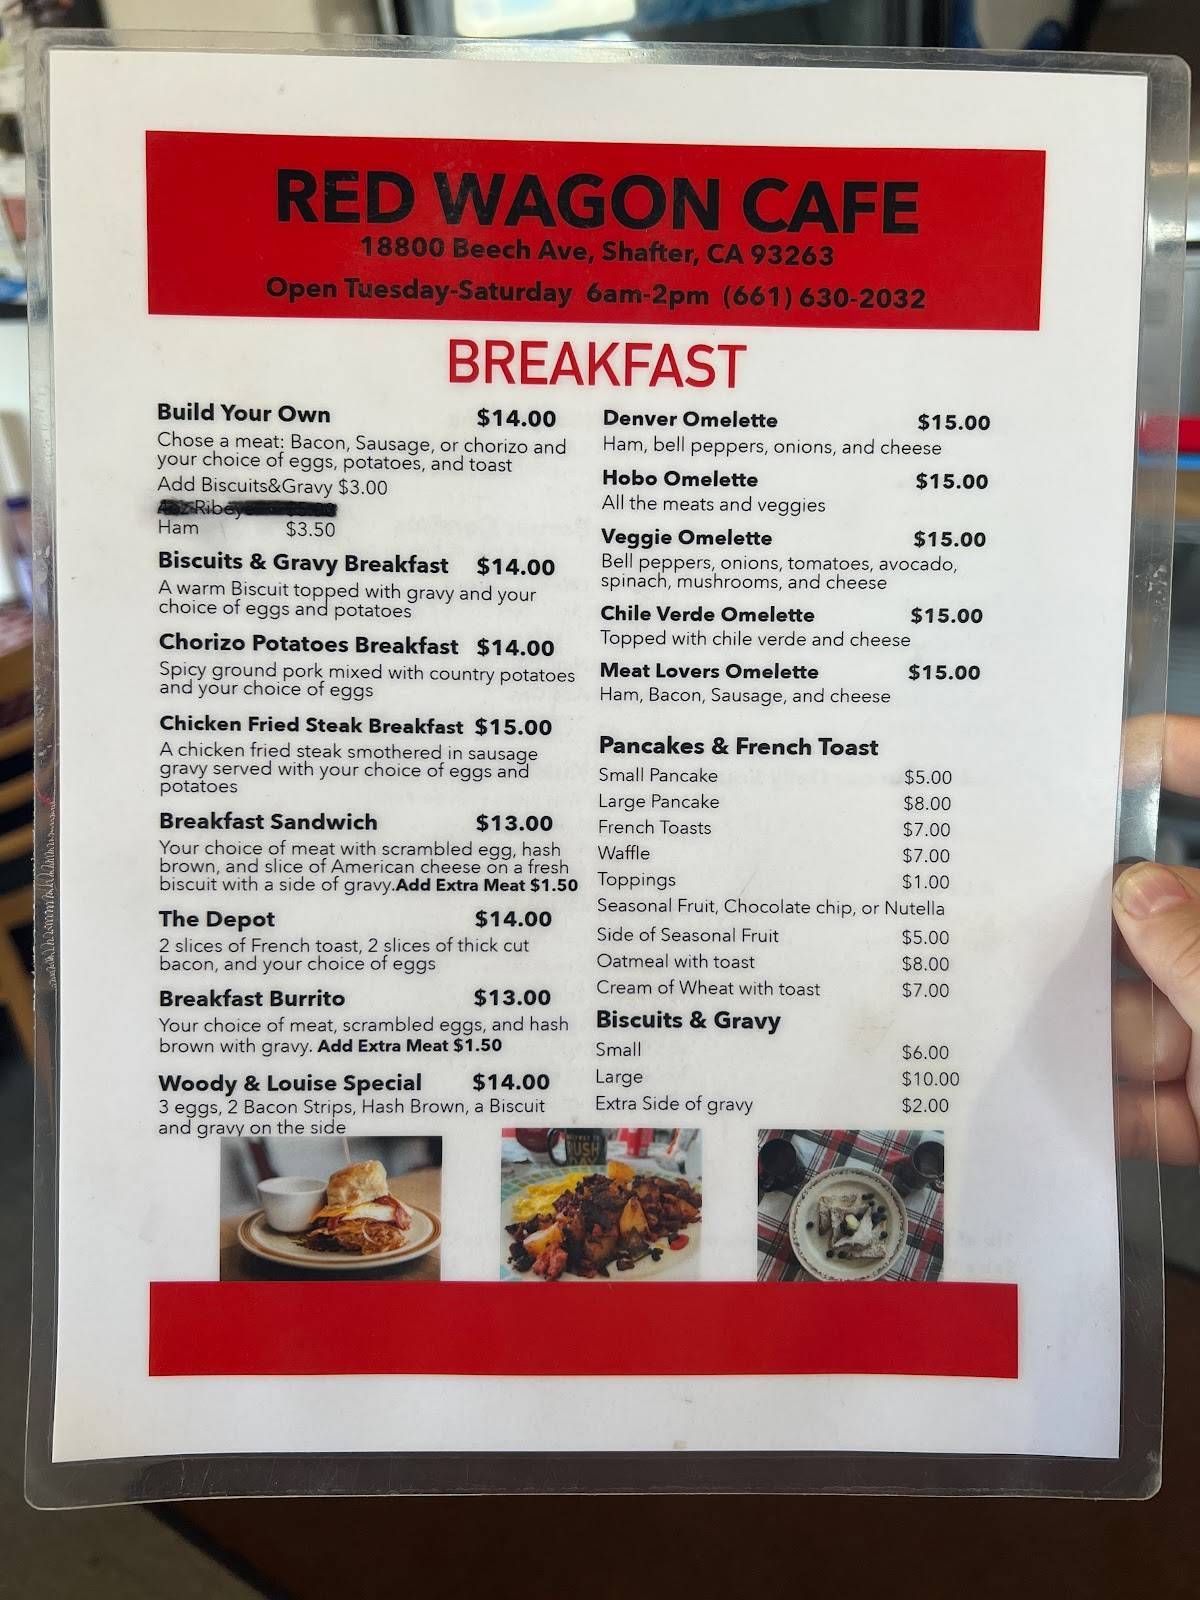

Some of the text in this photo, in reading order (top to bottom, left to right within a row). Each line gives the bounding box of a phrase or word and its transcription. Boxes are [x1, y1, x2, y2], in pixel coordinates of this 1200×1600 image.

[277, 168, 919, 234] RED WAGON CAFE
[361, 236, 833, 266] 18800 Beech Ave, Shafter, CA 93263
[266, 276, 925, 310] Open Tuesday-Saturday 6am-2pm (661) 630-2032
[449, 338, 747, 389] BREAKFAST
[157, 402, 556, 428] Build Your Own $14.00
[603, 409, 991, 432] Denver Omelette $15.00
[603, 435, 942, 458] Ham, bell peppers, onions, and cheese
[157, 475, 388, 499] Add Biscuits&Gravy $3.00
[603, 469, 989, 491] Hobo Omelette $15.00
[158, 519, 335, 538] Ham $3.50
[601, 528, 986, 550] Veggie Omelette $15.00
[159, 550, 555, 577] Biscuits & Gravy Breakfast $14.00
[602, 552, 957, 574] Bell peppers, onions, tomatoes, avocado,
[601, 572, 887, 592] spinach, mushrooms, and cheese
[600, 604, 983, 625] Chile Verde Omelette $15.00
[159, 632, 555, 657] Chorizo Potatoes Breakfast $14.00
[600, 662, 981, 681] Meat Lovers Omelette $15.00
[600, 686, 891, 707] Ham, Bacon, Sausage, and cheese
[159, 714, 552, 737] Chicken Fried Steak Breakfast $15.00
[600, 735, 879, 756] Pancakes & French Toast
[599, 767, 952, 786] Small Pancake $5.00
[599, 793, 951, 812] Large Pancake $8.00
[160, 811, 553, 833] Breakfast Sandwich $13.00
[599, 818, 951, 838] French Toasts $7.00
[597, 844, 950, 864] Waffle $7.00
[597, 871, 950, 891] Toppings $1.00
[597, 897, 945, 919] Seasonal Fruit, Chocolate chip, or Nutella
[158, 909, 552, 933] The Depot $14.00
[597, 926, 950, 946] Side of Seasonal Fruit $5.00
[597, 953, 950, 972] Oatmeal with toast $8.00
[159, 988, 551, 1008] Breakfast Burrito $13.00
[596, 978, 950, 998] Cream of Wheat with toast $7.00
[596, 1009, 782, 1035] Biscuits & Gravy
[596, 1041, 949, 1061] Small $6.00
[158, 1072, 550, 1097] Woody & Louise Special $14.00
[596, 1068, 960, 1088] Large $10.00
[159, 1097, 546, 1119] 3 eggs, 2 Bacon Strips, Hash Brown, a Biscuit
[596, 1094, 949, 1116] Extra Side of gravy $2.00
